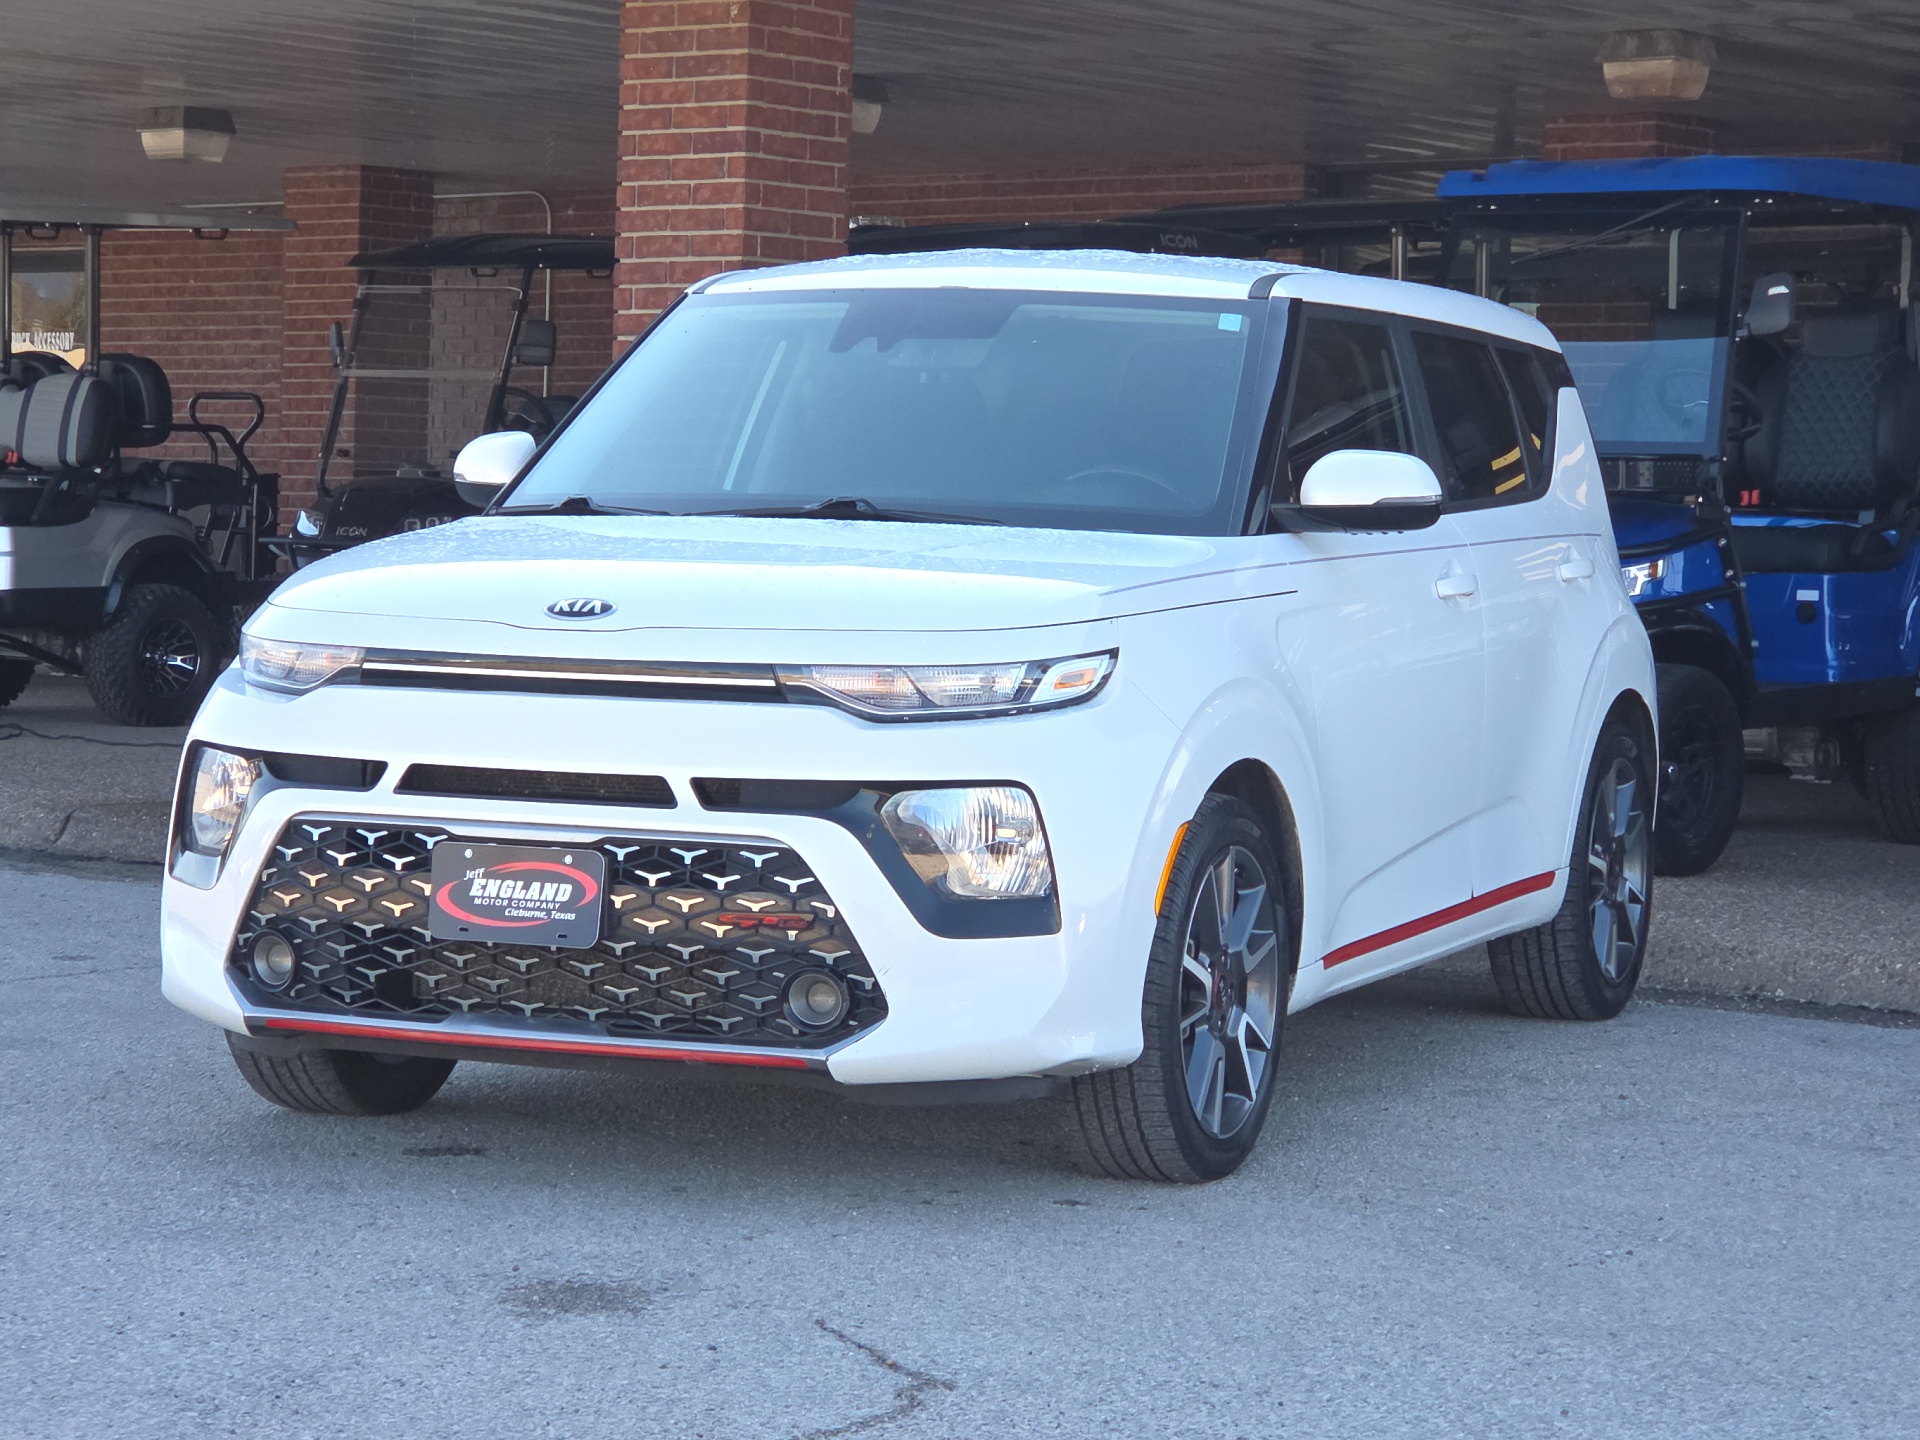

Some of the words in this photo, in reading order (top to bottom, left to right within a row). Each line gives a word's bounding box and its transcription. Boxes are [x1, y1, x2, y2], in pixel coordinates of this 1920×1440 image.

[1160, 234, 1198, 248] ICON
[34, 332, 74, 350] ACCESSORY
[336, 526, 367, 536] ICON
[553, 599, 602, 614] KIA
[463, 867, 485, 880] Jeff
[469, 878, 572, 902] ENGLAND
[473, 897, 508, 907] MOTOR
[511, 900, 560, 909] COMPANY
[504, 908, 548, 920] Cleburne,
[550, 911, 576, 920] Texas
